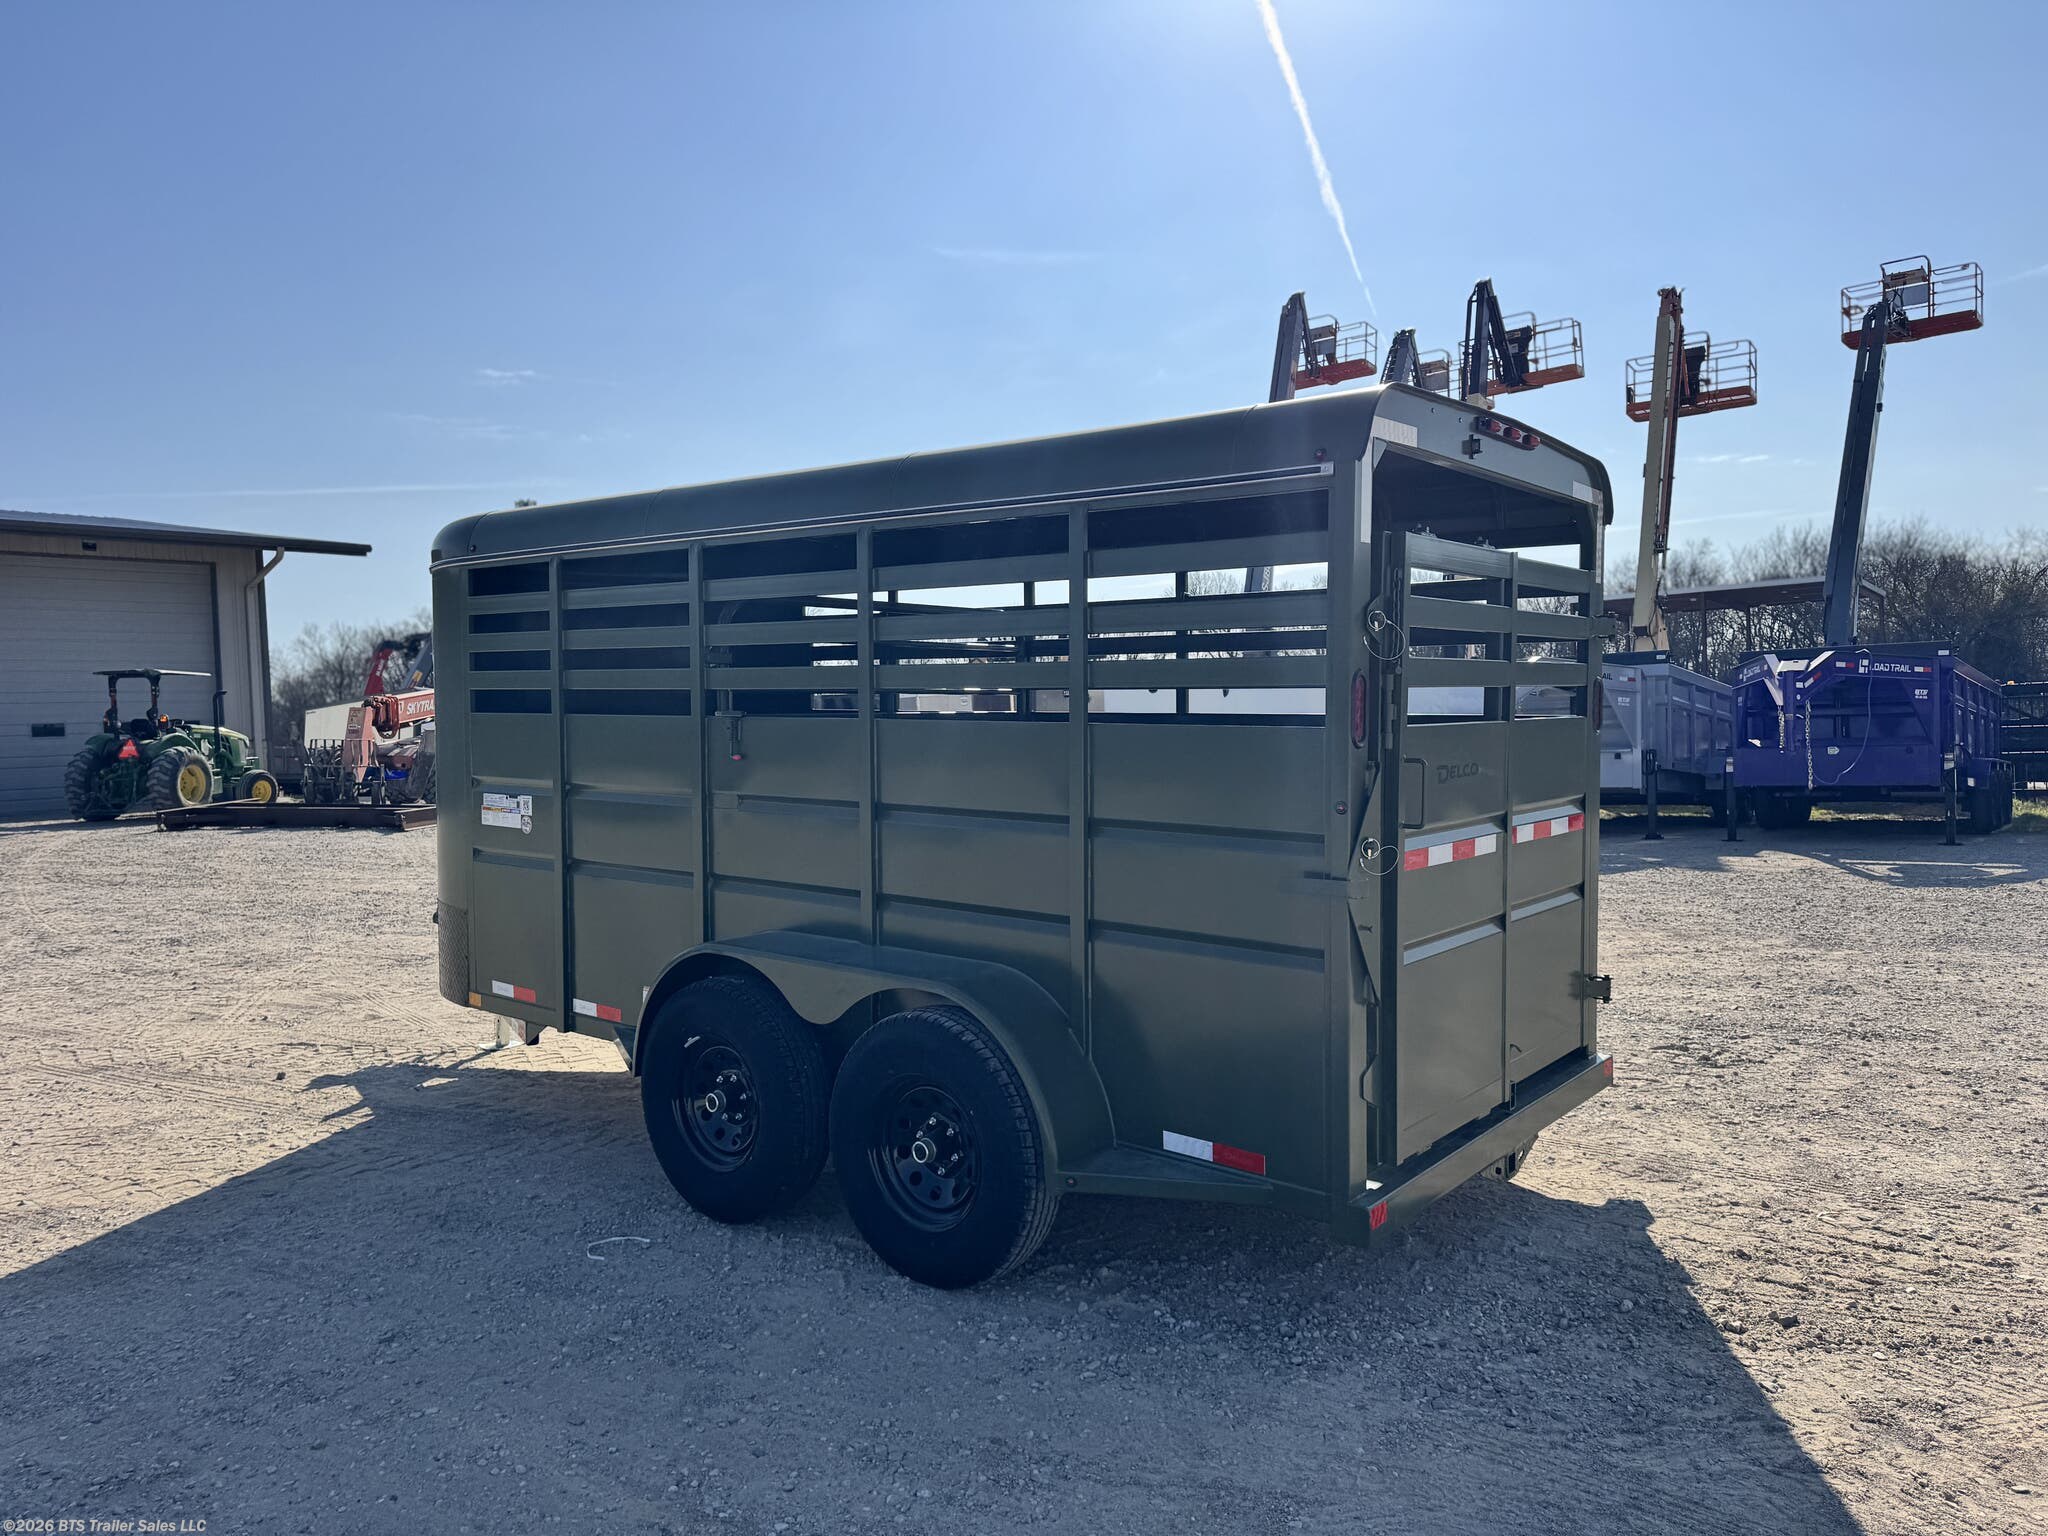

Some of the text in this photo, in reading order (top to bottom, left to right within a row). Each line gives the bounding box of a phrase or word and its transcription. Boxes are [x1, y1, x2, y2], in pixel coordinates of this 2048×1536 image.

[1890, 663, 1911, 673] TRAIL
[407, 699, 435, 715] SKYTRA
[1437, 763, 1480, 784] DELCO
